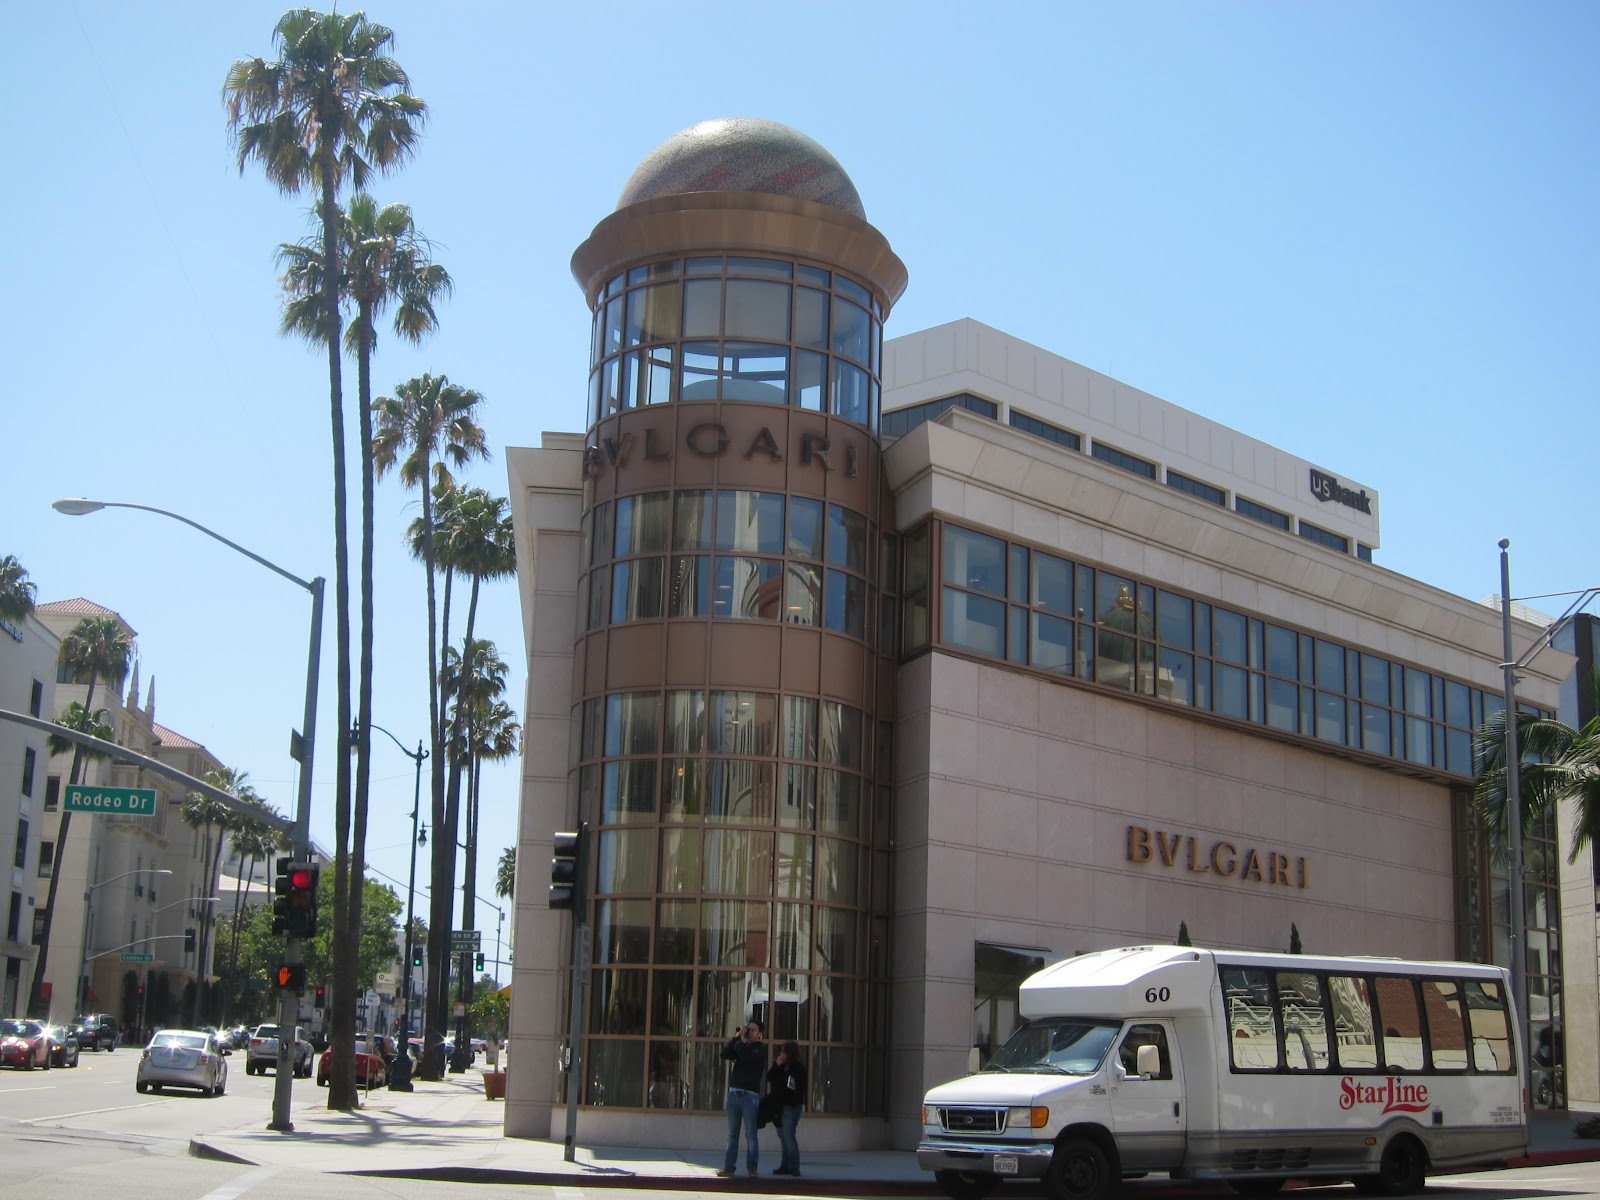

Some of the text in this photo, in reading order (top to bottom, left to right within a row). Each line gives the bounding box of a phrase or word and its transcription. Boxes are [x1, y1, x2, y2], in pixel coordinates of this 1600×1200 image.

[581, 422, 859, 481] BVLGARI
[71, 791, 148, 809] Rodeo Dr
[1127, 825, 1309, 889] BVLGARI
[1145, 986, 1171, 1003] 60
